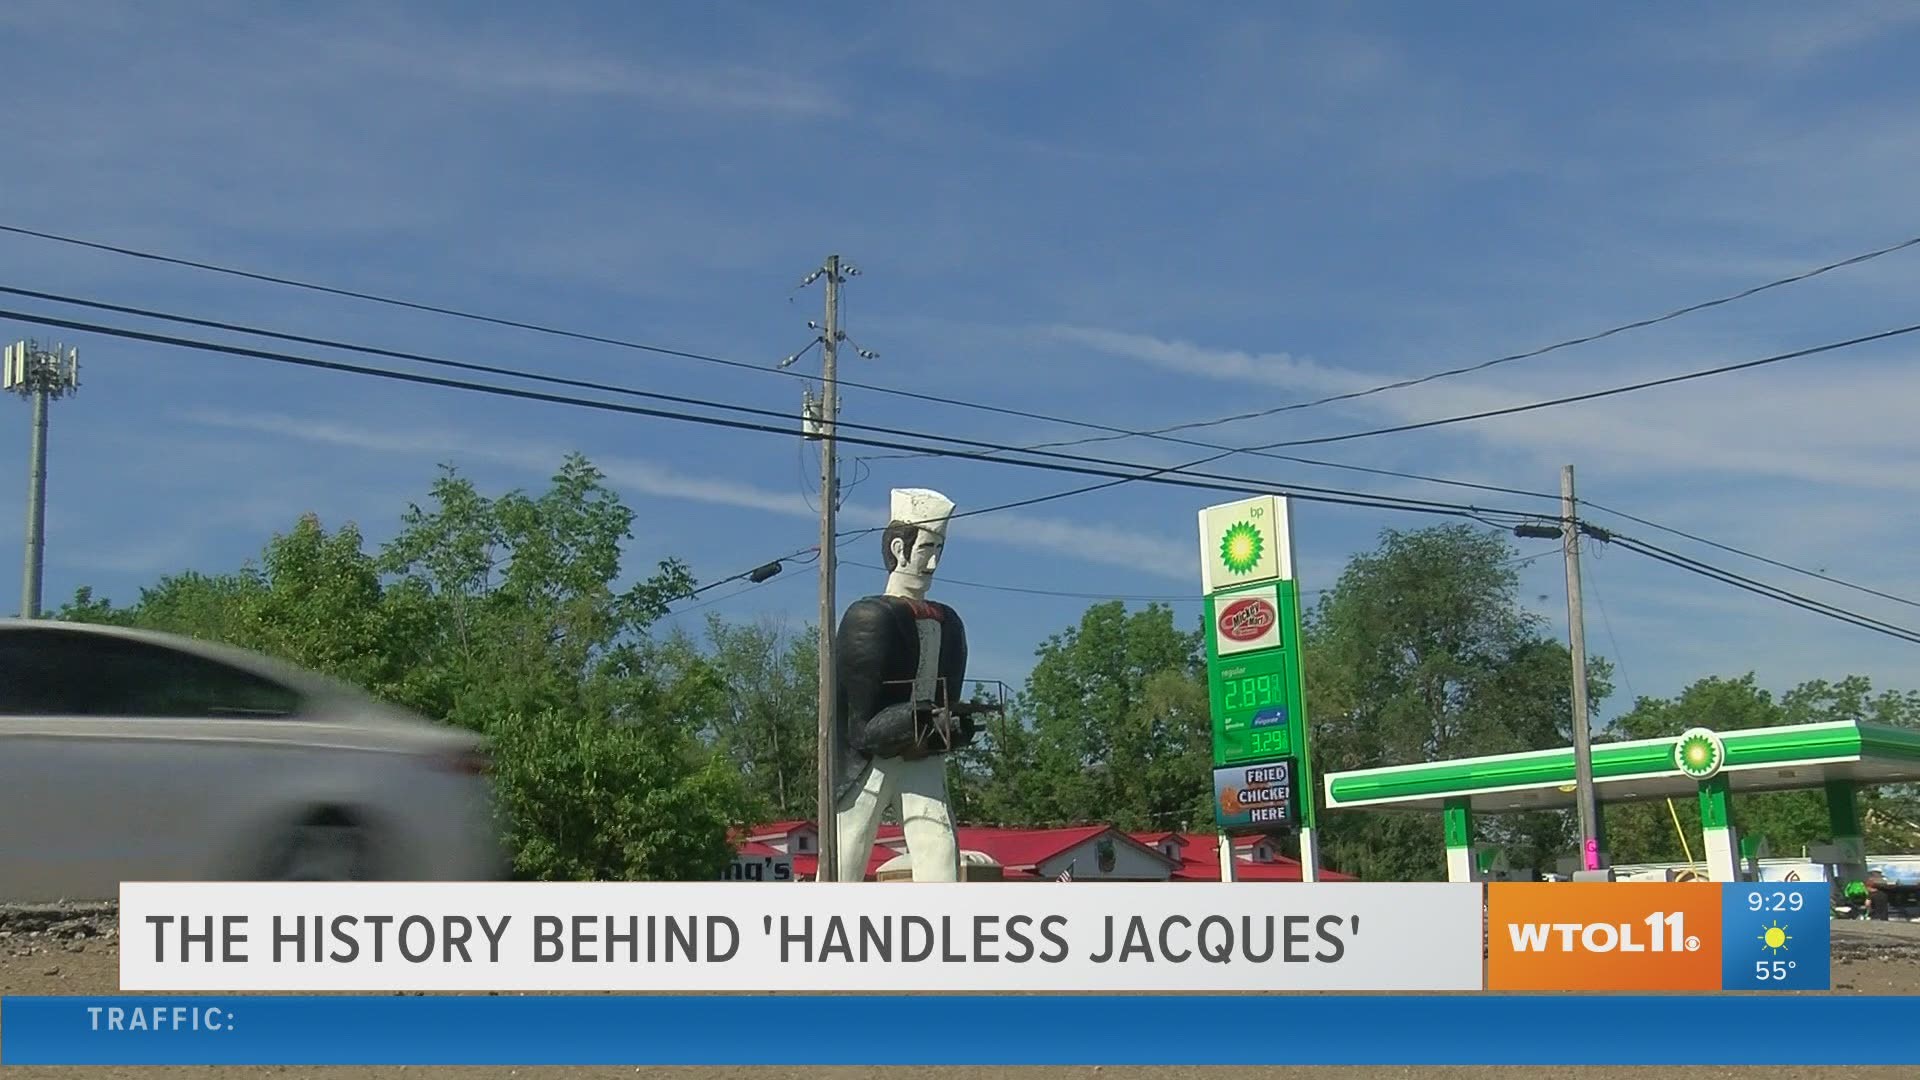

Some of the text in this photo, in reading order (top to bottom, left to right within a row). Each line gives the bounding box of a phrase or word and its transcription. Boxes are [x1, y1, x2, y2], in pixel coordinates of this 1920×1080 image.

[1250, 507, 1264, 519] bp
[1248, 767, 1285, 782] FRIED
[1251, 807, 1285, 822] HERE
